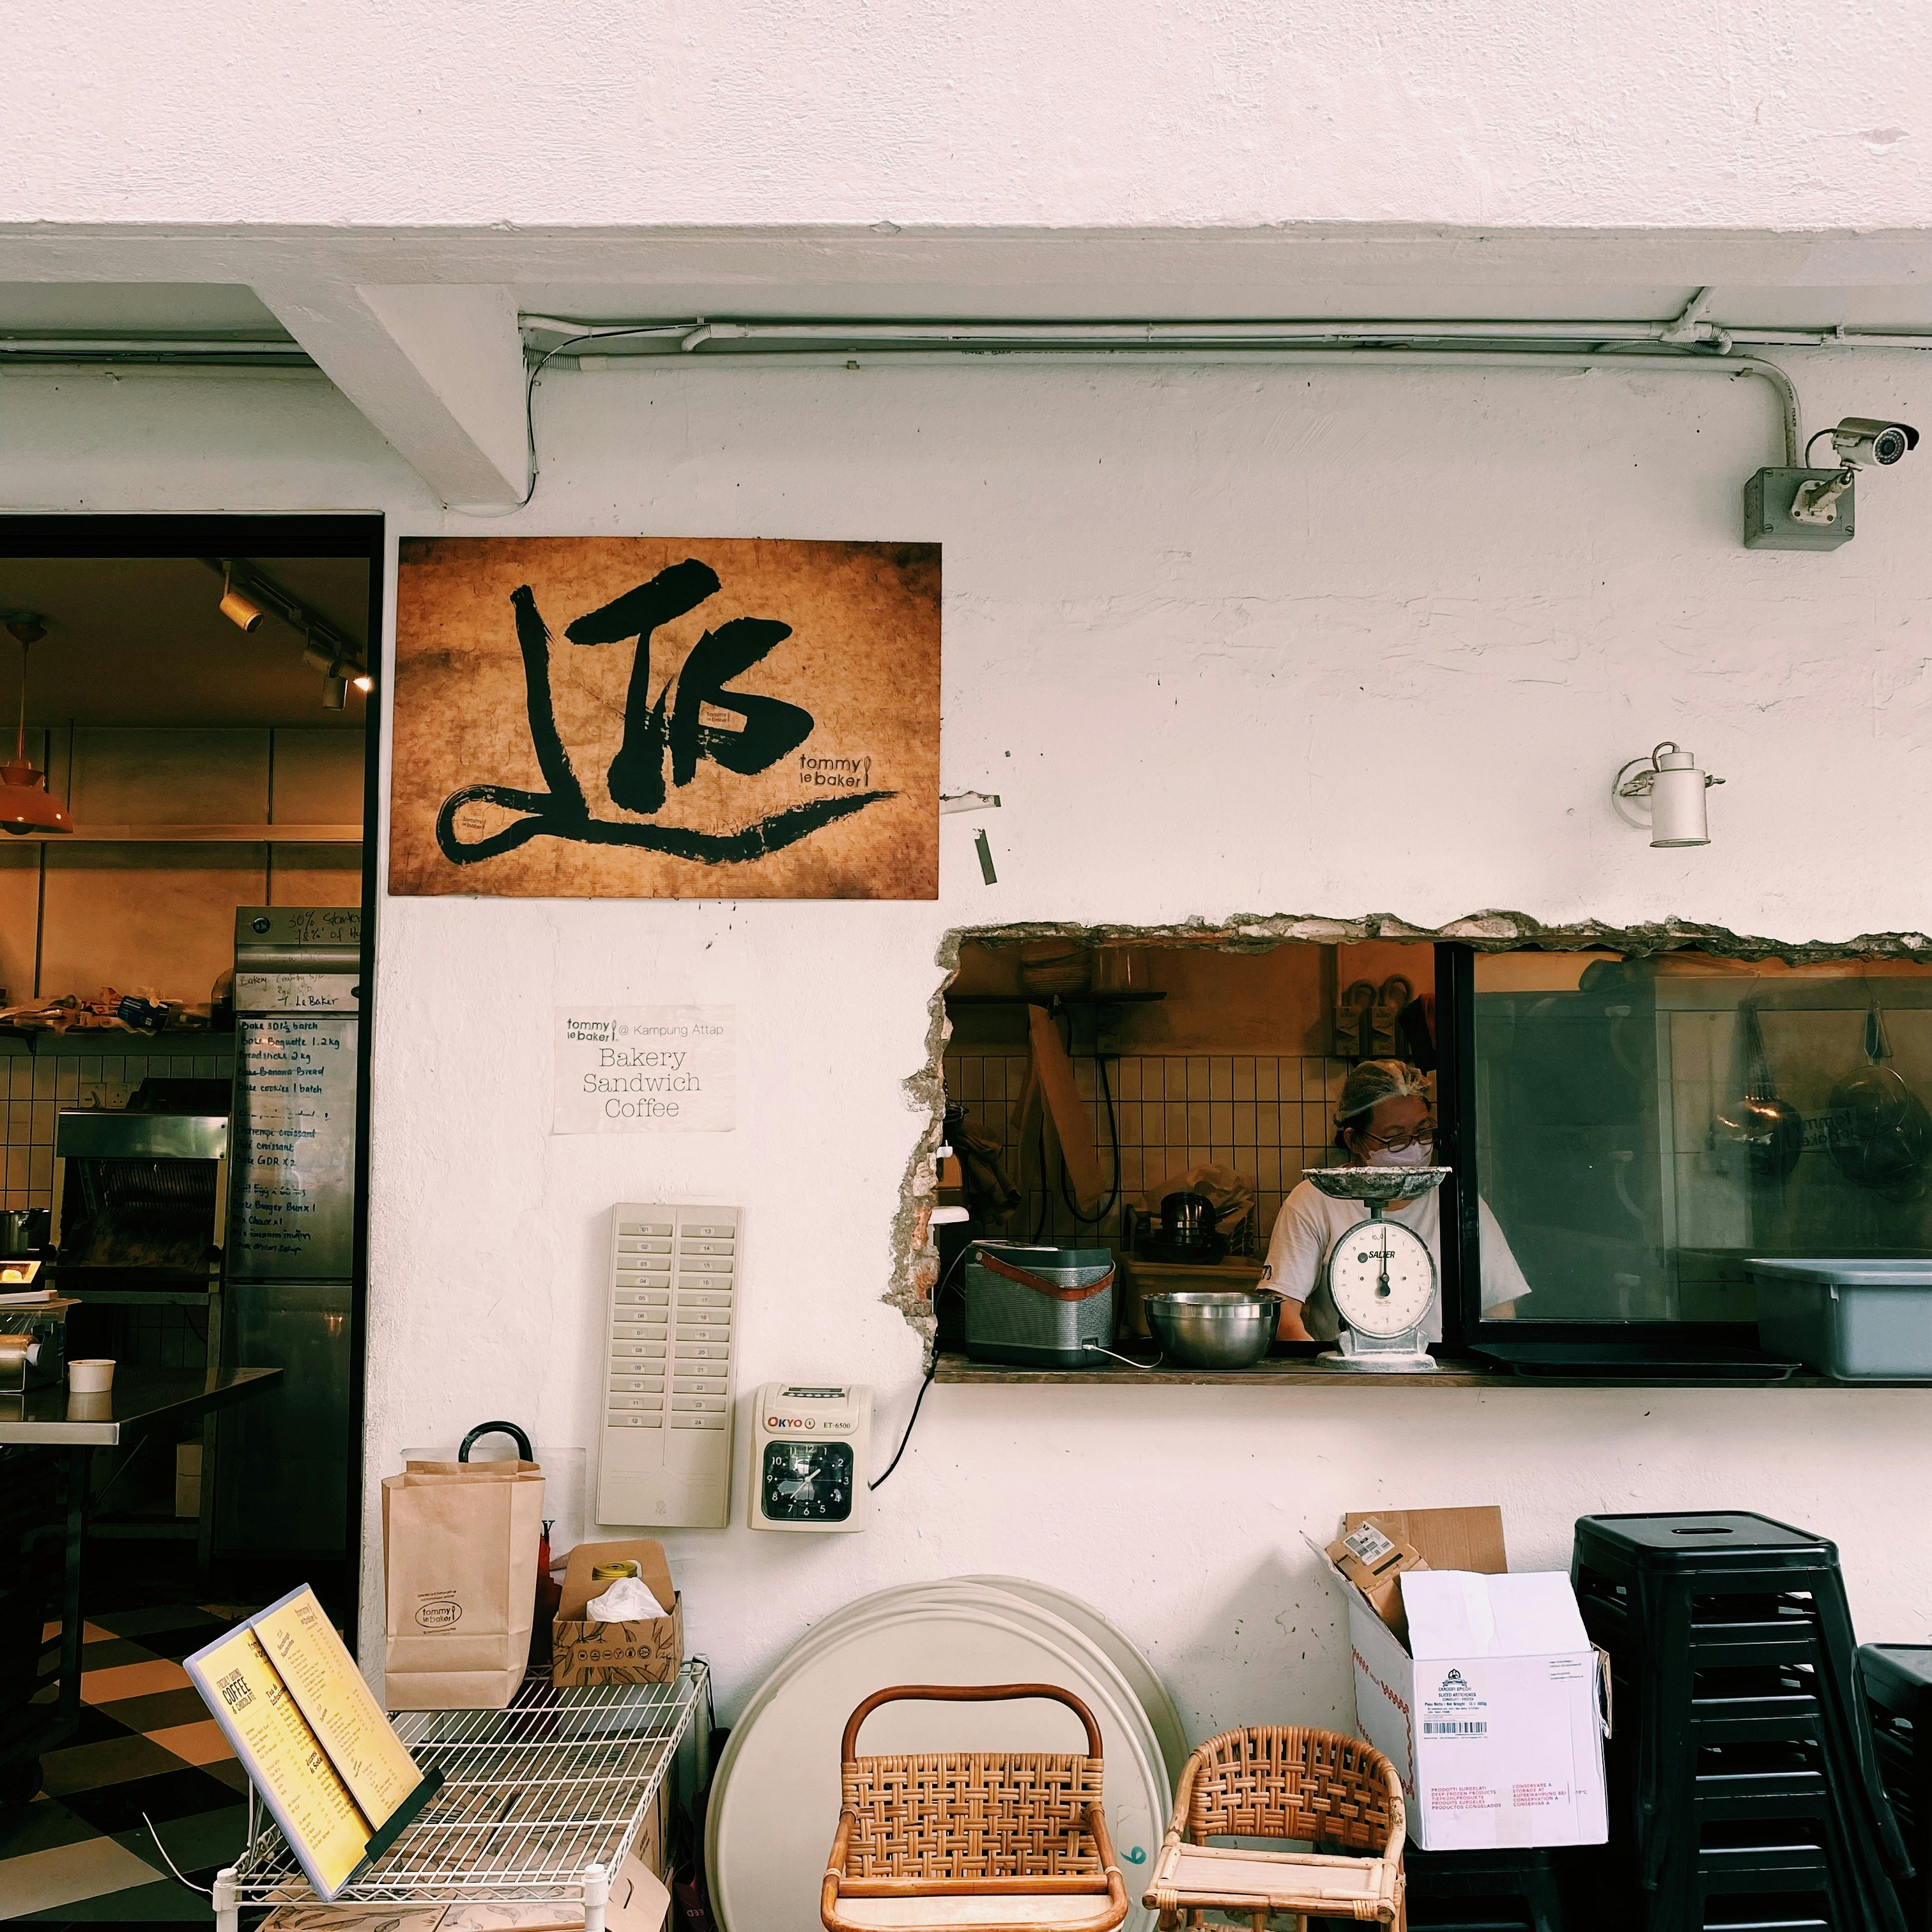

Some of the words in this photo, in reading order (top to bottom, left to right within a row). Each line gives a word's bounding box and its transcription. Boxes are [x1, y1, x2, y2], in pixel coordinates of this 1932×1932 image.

[800, 754, 861, 773] tommy
[800, 772, 812, 783] le
[814, 771, 861, 788] baker
[567, 1018, 610, 1031] tommy
[618, 1025, 629, 1036] @
[634, 1025, 688, 1037] Kampung
[692, 1024, 723, 1035] Attap
[577, 1031, 610, 1042] baker
[268, 1037, 307, 1049] Baguette
[599, 1048, 687, 1070] Bakery
[296, 1066, 325, 1077] Bread
[583, 1072, 703, 1093] Sandwich
[260, 1084, 289, 1092] cookies
[300, 1084, 322, 1094] batch
[605, 1098, 679, 1117] Coffee
[257, 1156, 279, 1165] GDR
[768, 1416, 802, 1428] OKYO
[790, 1446, 797, 1455] 11
[805, 1445, 815, 1453] 12
[772, 1457, 782, 1466] 10
[838, 1459, 844, 1468] 2
[767, 1475, 772, 1483] 9
[843, 1476, 849, 1485] 3
[772, 1493, 778, 1501] 8
[834, 1494, 841, 1503] 4
[788, 1505, 793, 1513] 7
[803, 1507, 809, 1515] 6
[820, 1505, 826, 1513] 5
[422, 1607, 451, 1616] tommy
[222, 1676, 251, 1705] COFFEE
